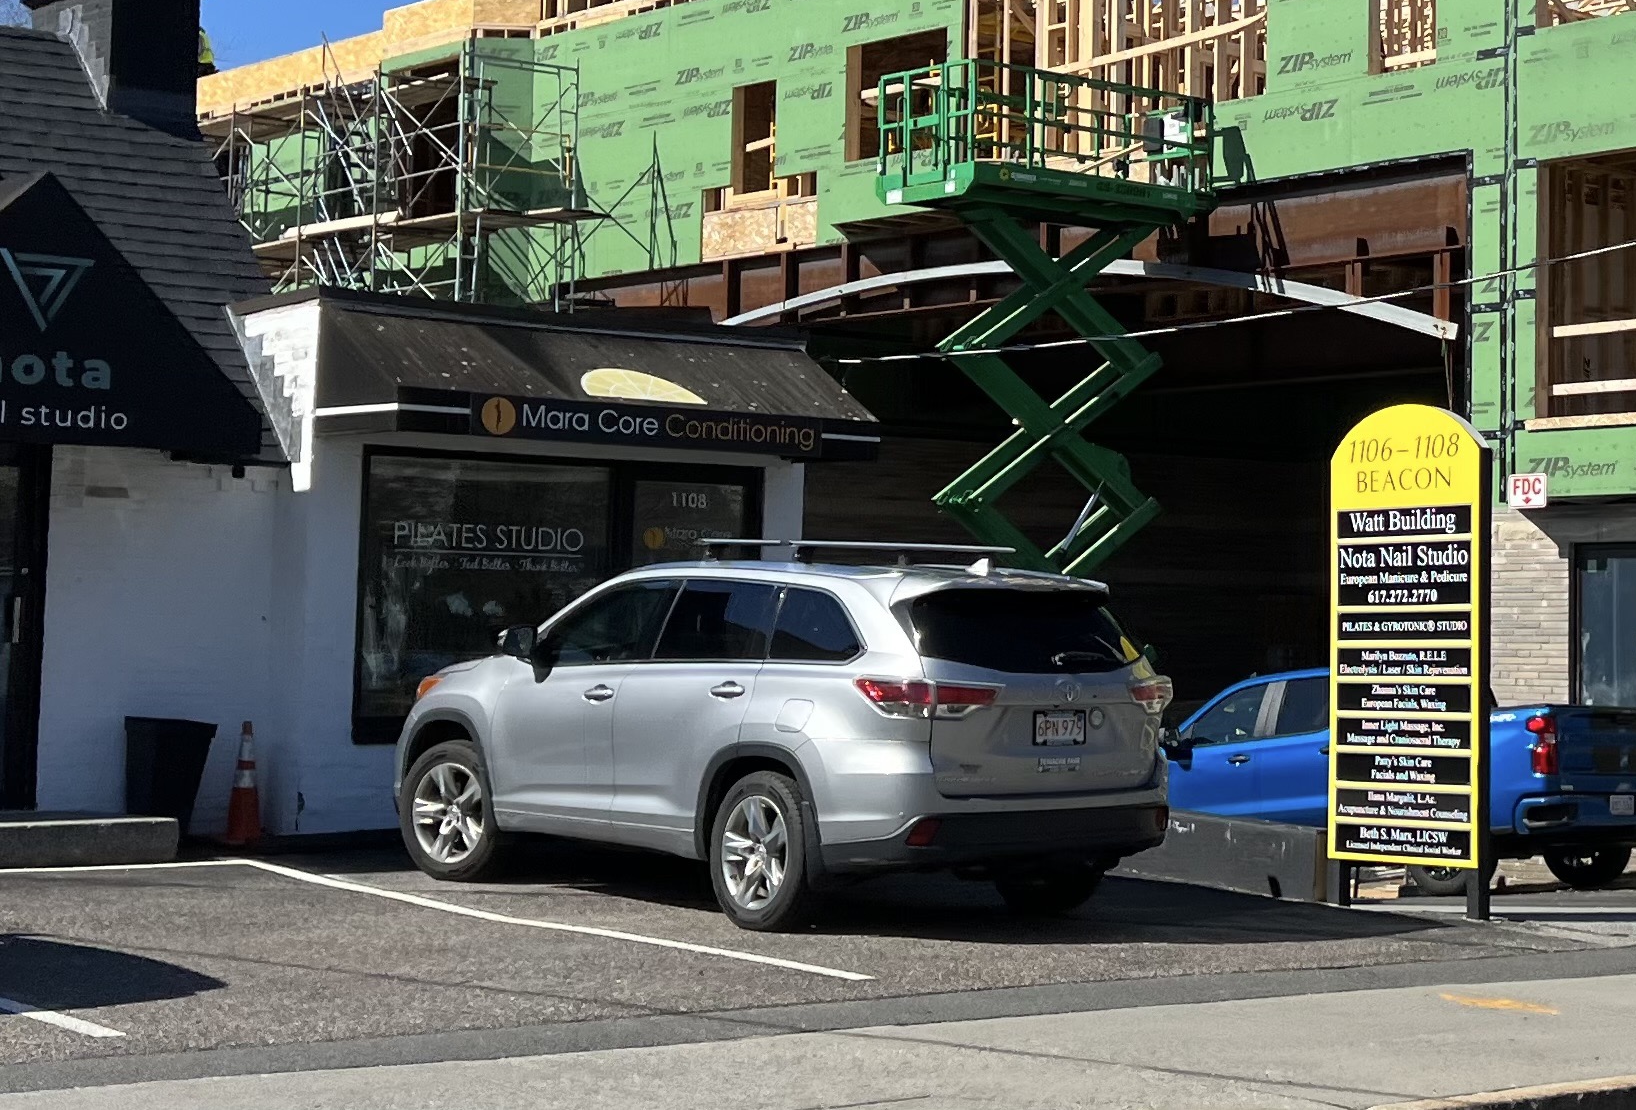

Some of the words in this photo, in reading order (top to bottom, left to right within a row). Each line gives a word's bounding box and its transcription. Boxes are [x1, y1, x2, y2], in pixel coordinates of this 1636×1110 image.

[0, 351, 111, 390] ota
[20, 404, 128, 430] studio
[522, 404, 589, 431] Mara
[598, 409, 659, 436] Core
[665, 413, 815, 450] Conditioning
[1357, 466, 1452, 493] BEACON
[1513, 478, 1541, 496] FDC
[672, 491, 706, 508] 1108
[1349, 512, 1385, 533] Watt
[1388, 508, 1456, 533] Building
[394, 521, 487, 548] PILATES
[494, 524, 584, 552] STUDIO
[1340, 548, 1376, 568] Nota
[1379, 545, 1412, 567] Nail
[1417, 543, 1468, 566] Studio
[1340, 573, 1378, 587] European
[1379, 572, 1419, 584] Manicure
[1420, 571, 1429, 583] &
[1430, 570, 1468, 583] Pedicure
[1367, 589, 1438, 603] 617.272.2770
[1342, 621, 1373, 631] PILATES
[1374, 621, 1380, 631] &
[1436, 620, 1467, 631] STUDIO
[1406, 664, 1422, 674] Skin
[1402, 685, 1419, 695] Skin
[1419, 685, 1436, 696] Care
[1398, 756, 1414, 767] Skin
[1415, 757, 1432, 768] Care
[1396, 770, 1409, 781] and
[1360, 827, 1379, 839] Beth
[1380, 828, 1389, 840] S.
[1416, 830, 1449, 843] LICSW
